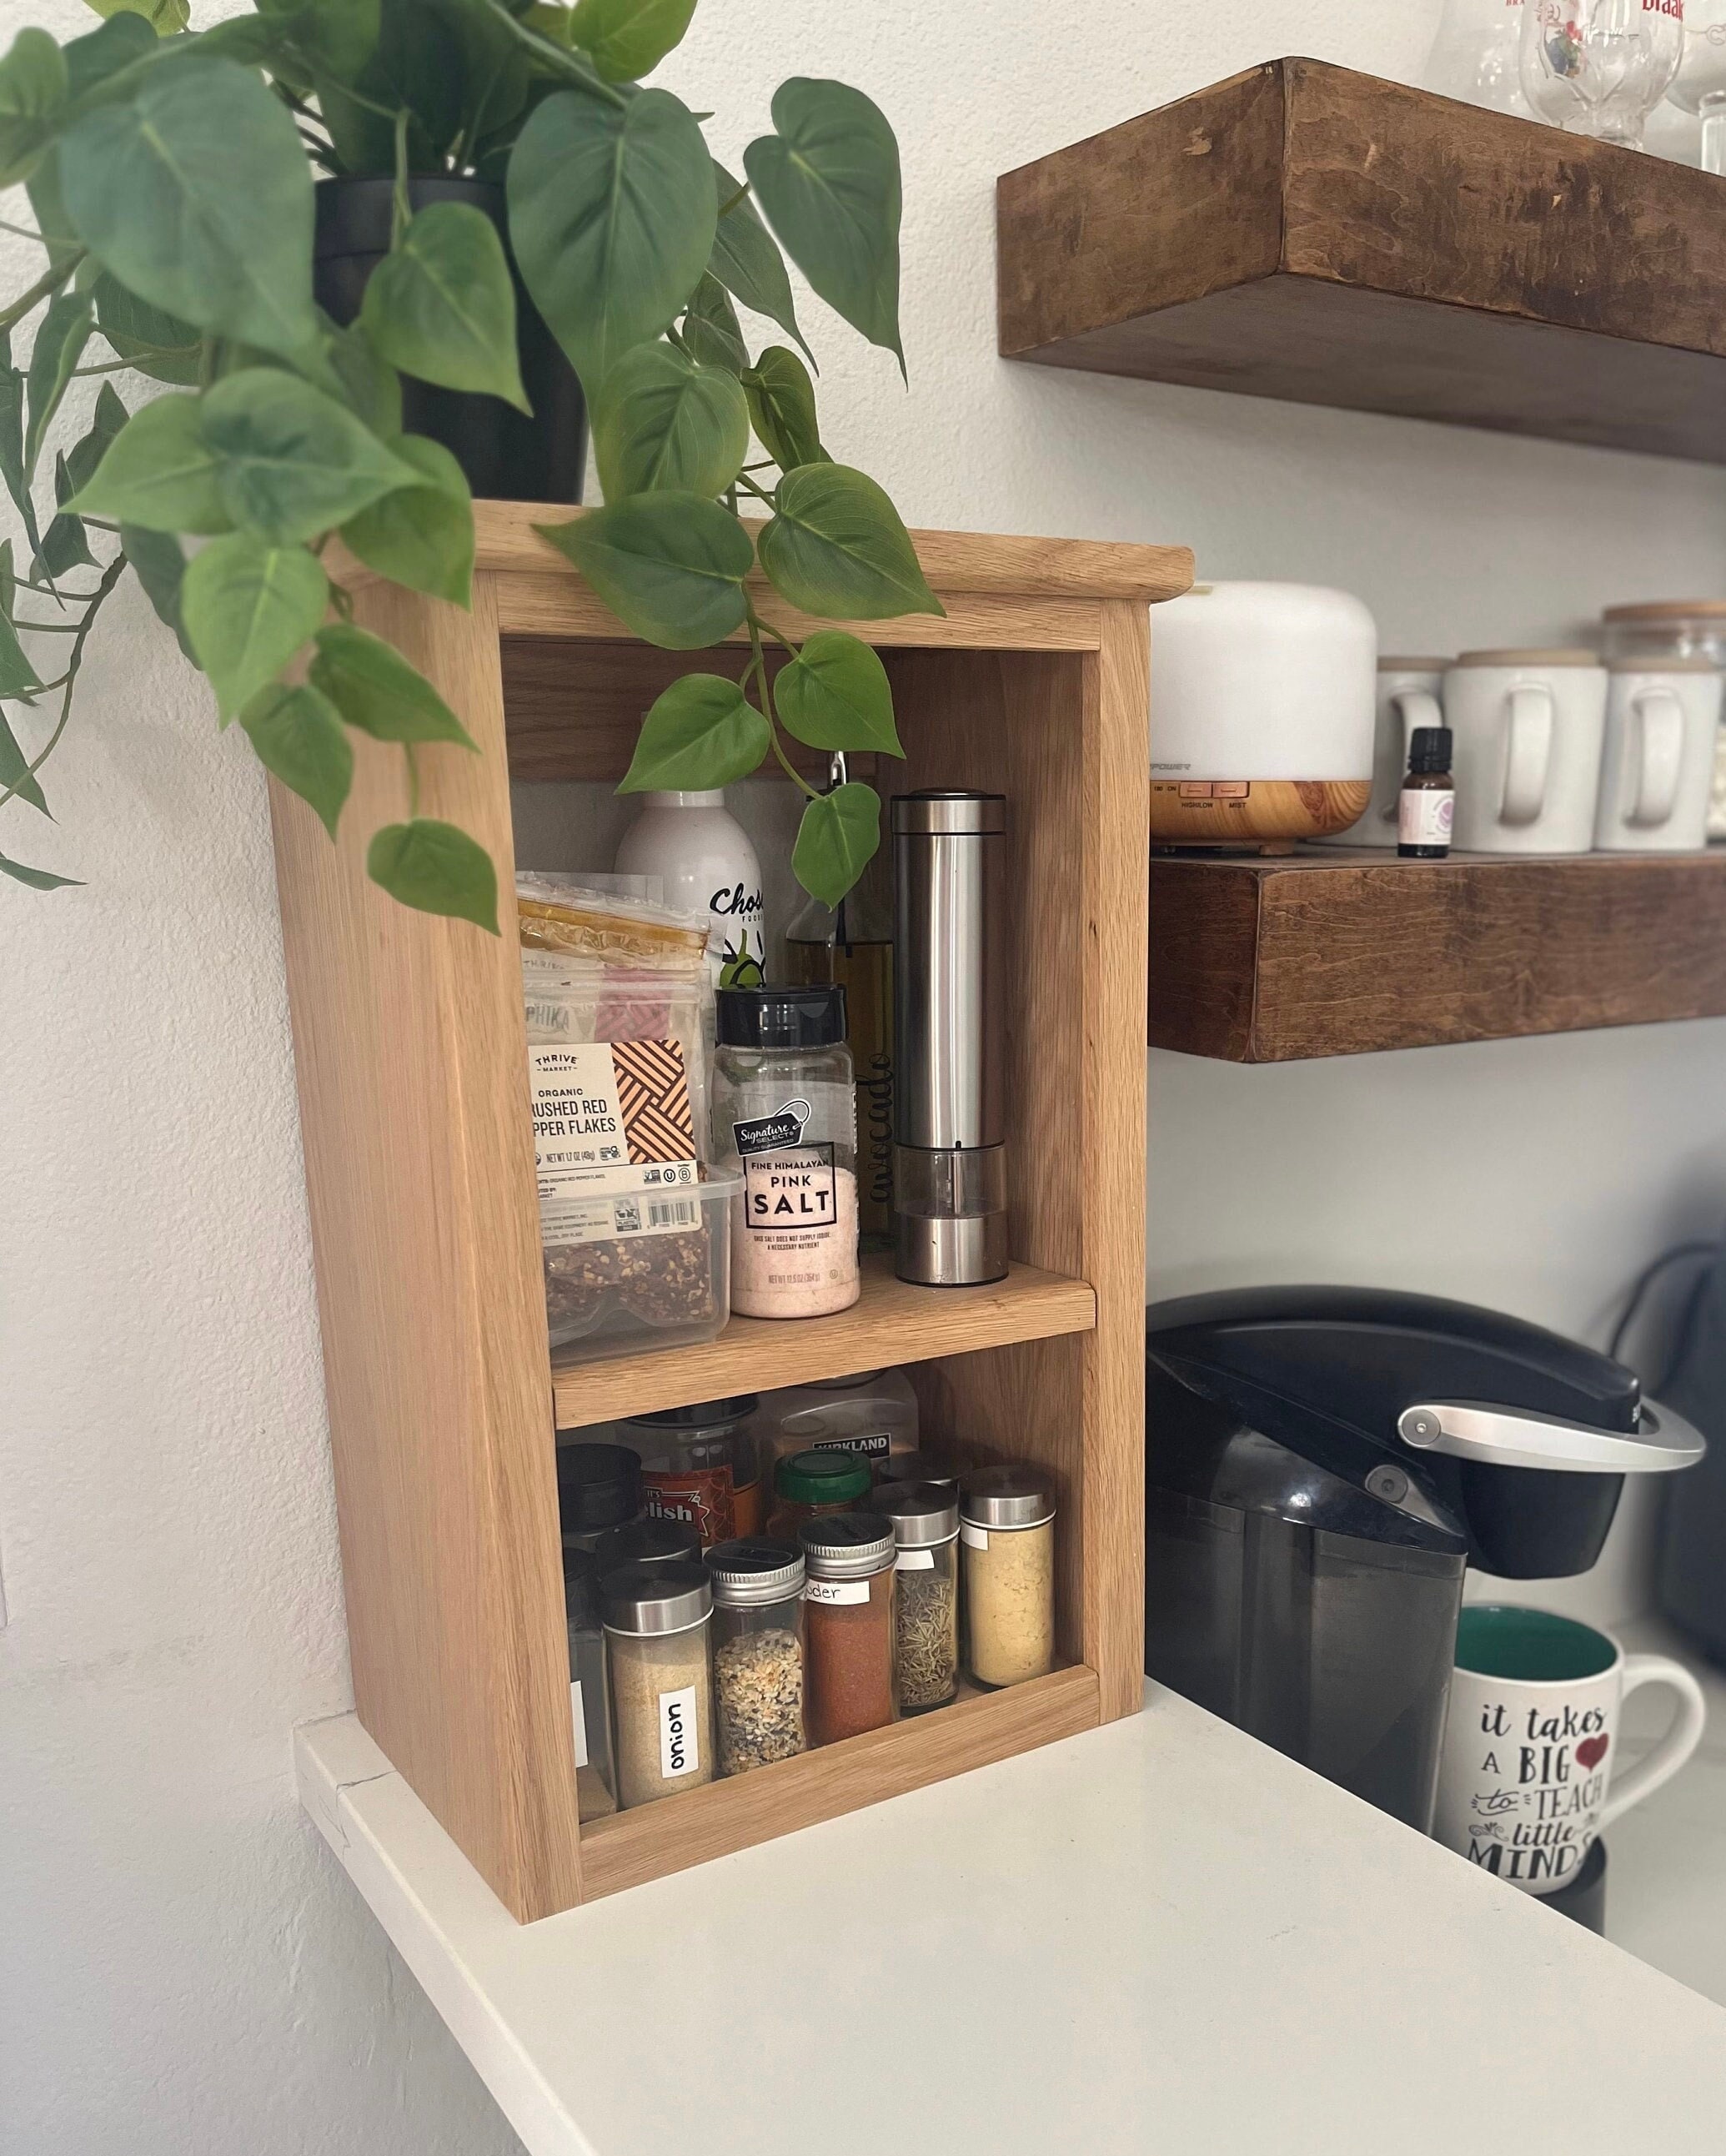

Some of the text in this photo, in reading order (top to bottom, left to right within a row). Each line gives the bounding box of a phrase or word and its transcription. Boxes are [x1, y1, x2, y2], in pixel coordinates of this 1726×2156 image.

[710, 882, 764, 914] Chos
[535, 1053, 579, 1066] THRIVE
[538, 1088, 584, 1098] ORGANIC
[532, 1099, 608, 1118] RUSHED RED
[534, 1118, 617, 1137] PPER FLAKES
[740, 1124, 790, 1144] Signature
[855, 1053, 894, 1204] avocado
[546, 1153, 557, 1163] NET
[775, 1160, 828, 1170] HIMALAYAN
[771, 1175, 811, 1188] PINK
[755, 1191, 829, 1214] SALT
[645, 1501, 693, 1521] lish
[1481, 1704, 1605, 1742] it takes
[668, 1703, 685, 1769] onion
[1481, 1744, 1570, 1784] A BIG
[1534, 1773, 1603, 1820] TEACH
[1512, 1822, 1574, 1847] little
